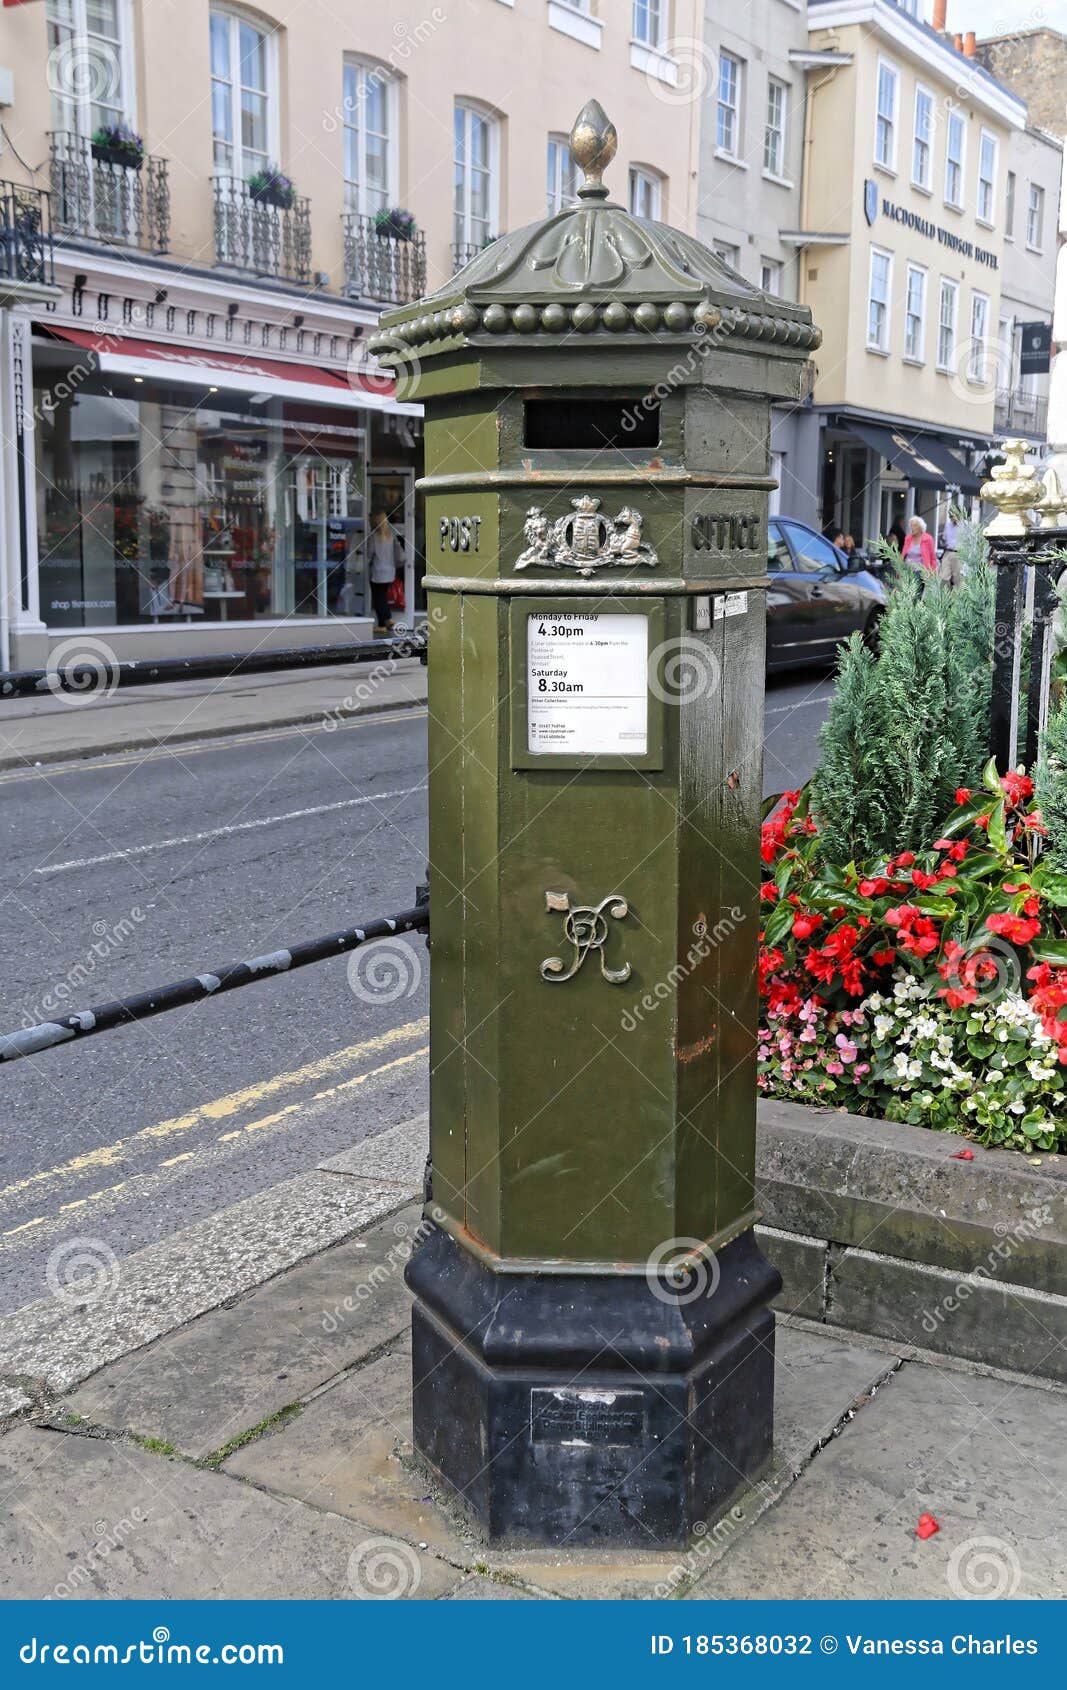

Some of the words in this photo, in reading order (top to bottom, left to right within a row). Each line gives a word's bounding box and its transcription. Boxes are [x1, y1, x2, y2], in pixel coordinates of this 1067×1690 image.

[882, 198, 936, 240] MACDONALD
[937, 227, 974, 258] WINDSOR
[974, 246, 999, 270] HOTEL
[440, 515, 481, 552] POST
[691, 512, 761, 551] OFFICE
[531, 613, 562, 622] Monday
[574, 613, 599, 622] Friday
[537, 622, 584, 638] 4.30pm
[531, 668, 568, 677] Saturday
[538, 678, 584, 692] 8.30am
